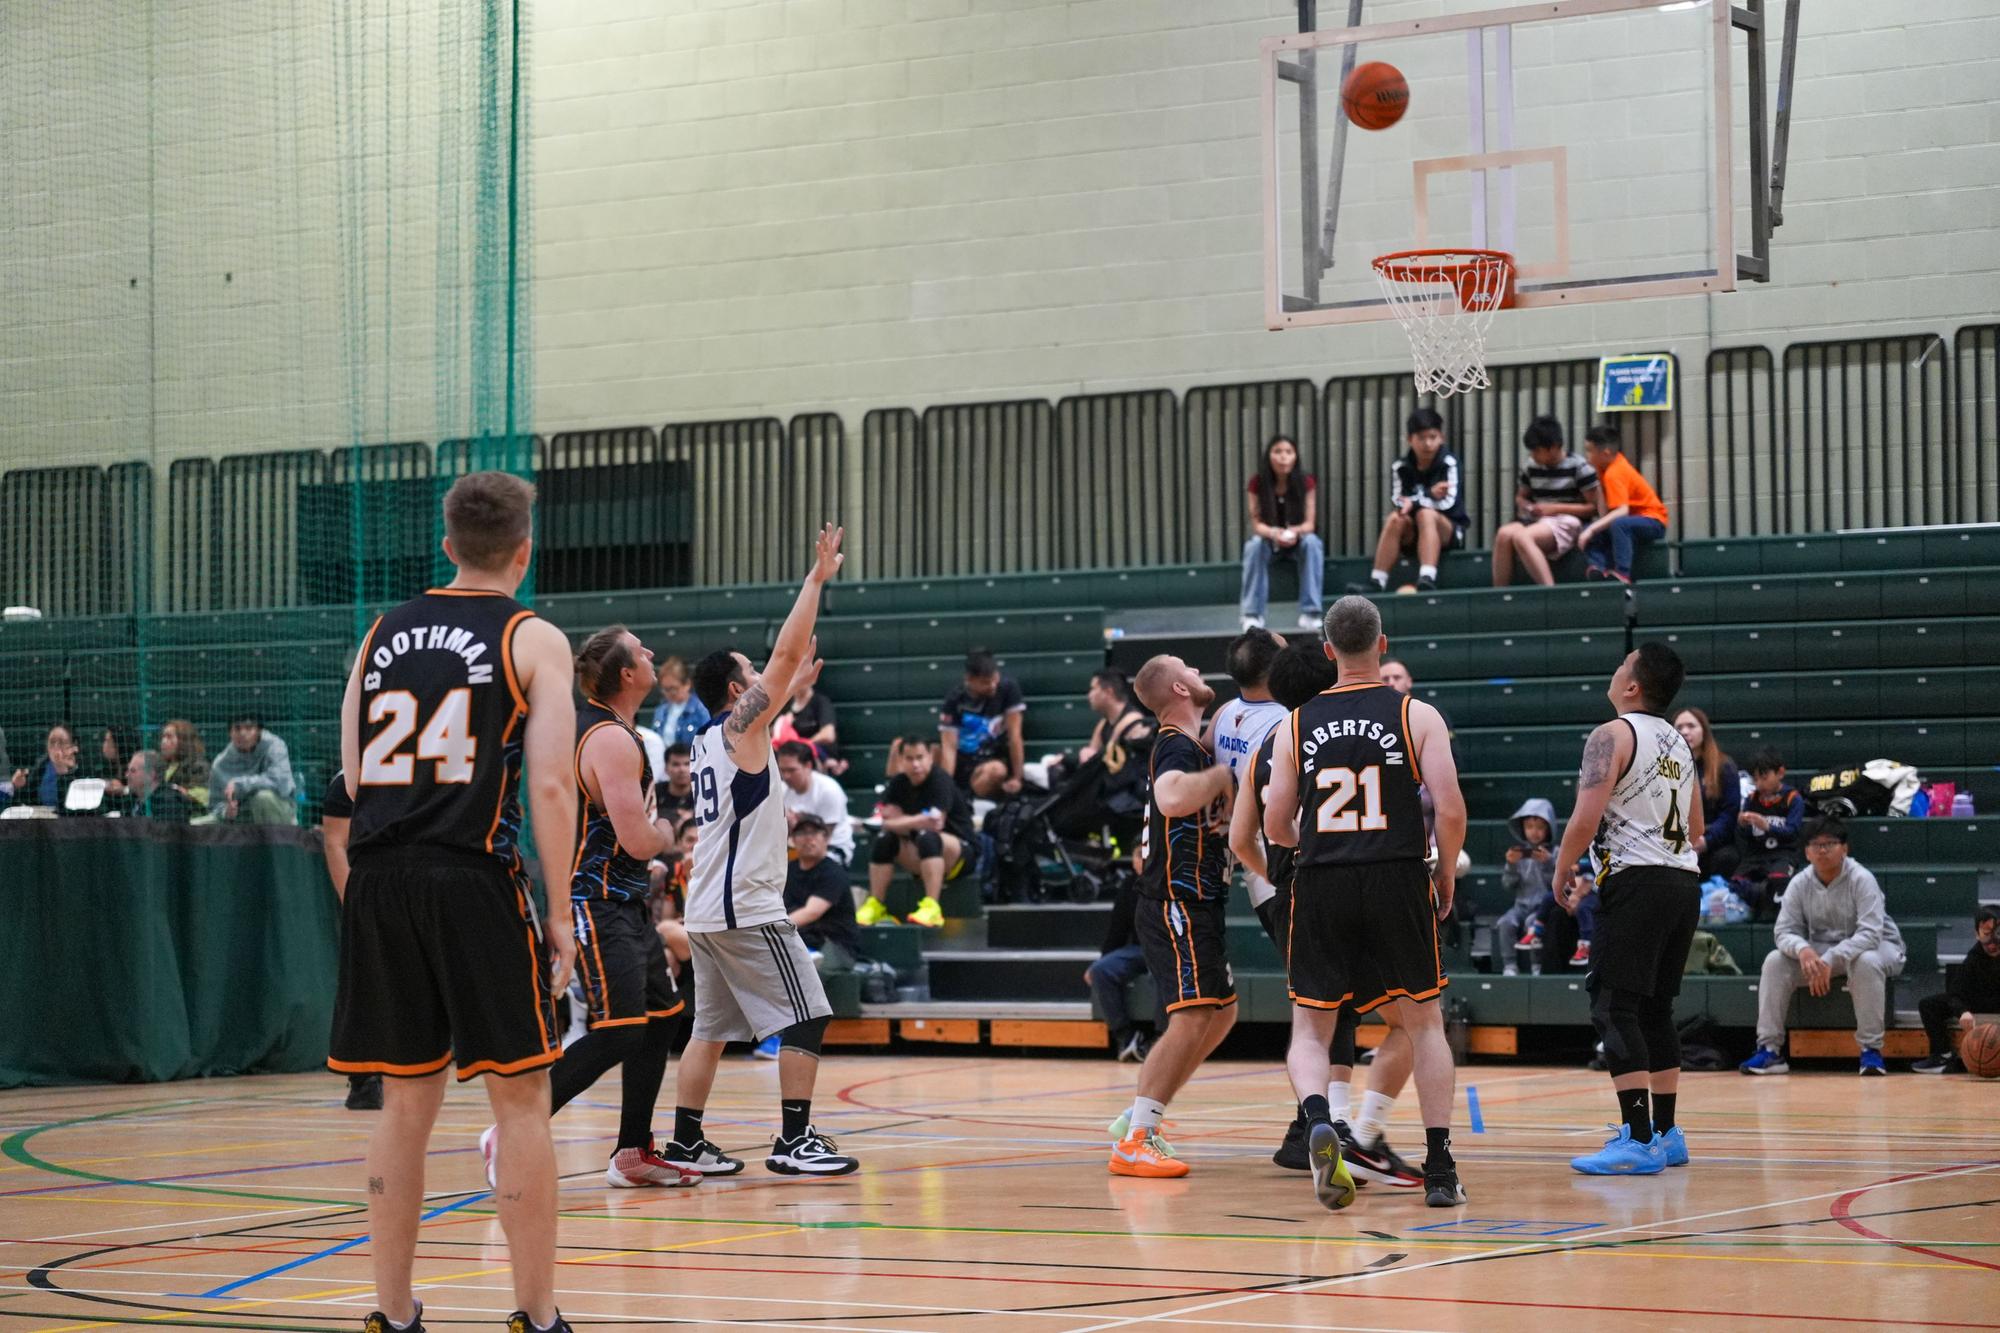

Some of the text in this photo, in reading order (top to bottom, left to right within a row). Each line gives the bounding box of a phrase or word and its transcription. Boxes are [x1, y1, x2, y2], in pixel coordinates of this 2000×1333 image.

[363, 625, 494, 692] BOOTHMAN
[359, 687, 478, 786] 24
[1302, 719, 1404, 774] ROBERTSON
[1315, 764, 1388, 833] 21
[1663, 788, 1685, 854] 4
